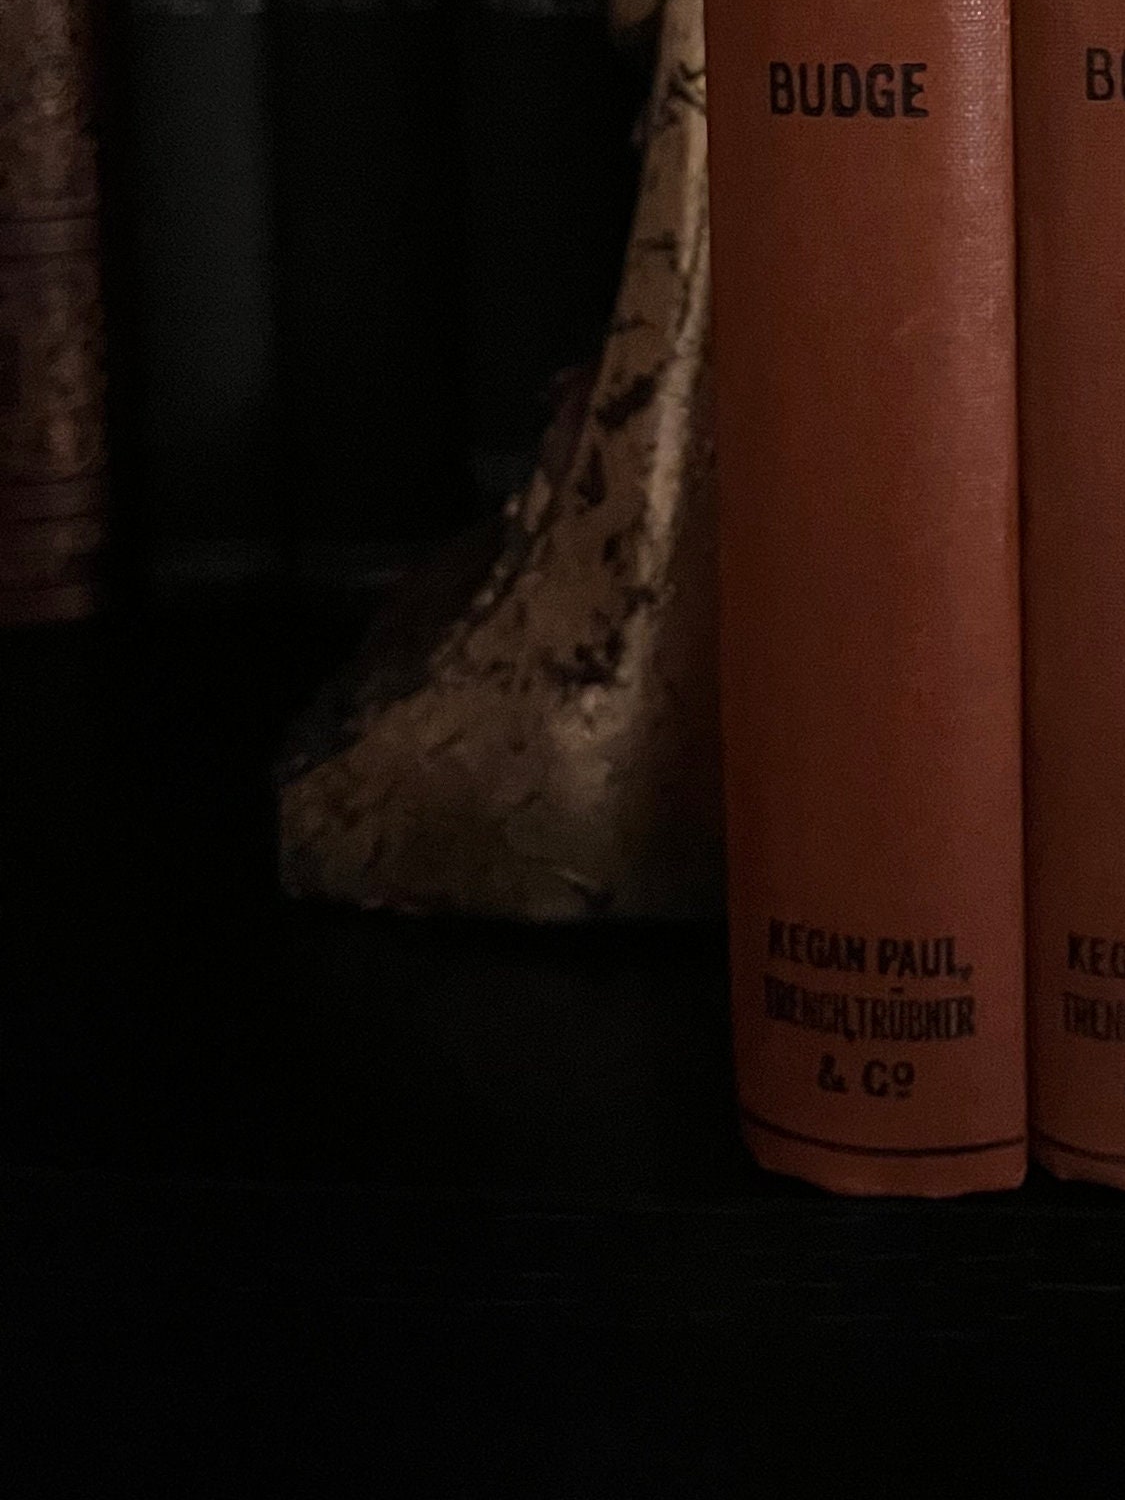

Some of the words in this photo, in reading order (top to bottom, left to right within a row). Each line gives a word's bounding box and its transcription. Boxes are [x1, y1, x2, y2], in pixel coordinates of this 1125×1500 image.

[768, 62, 930, 119] BUDGE
[768, 918, 867, 974] KEGAN
[817, 1053, 851, 1095] &
